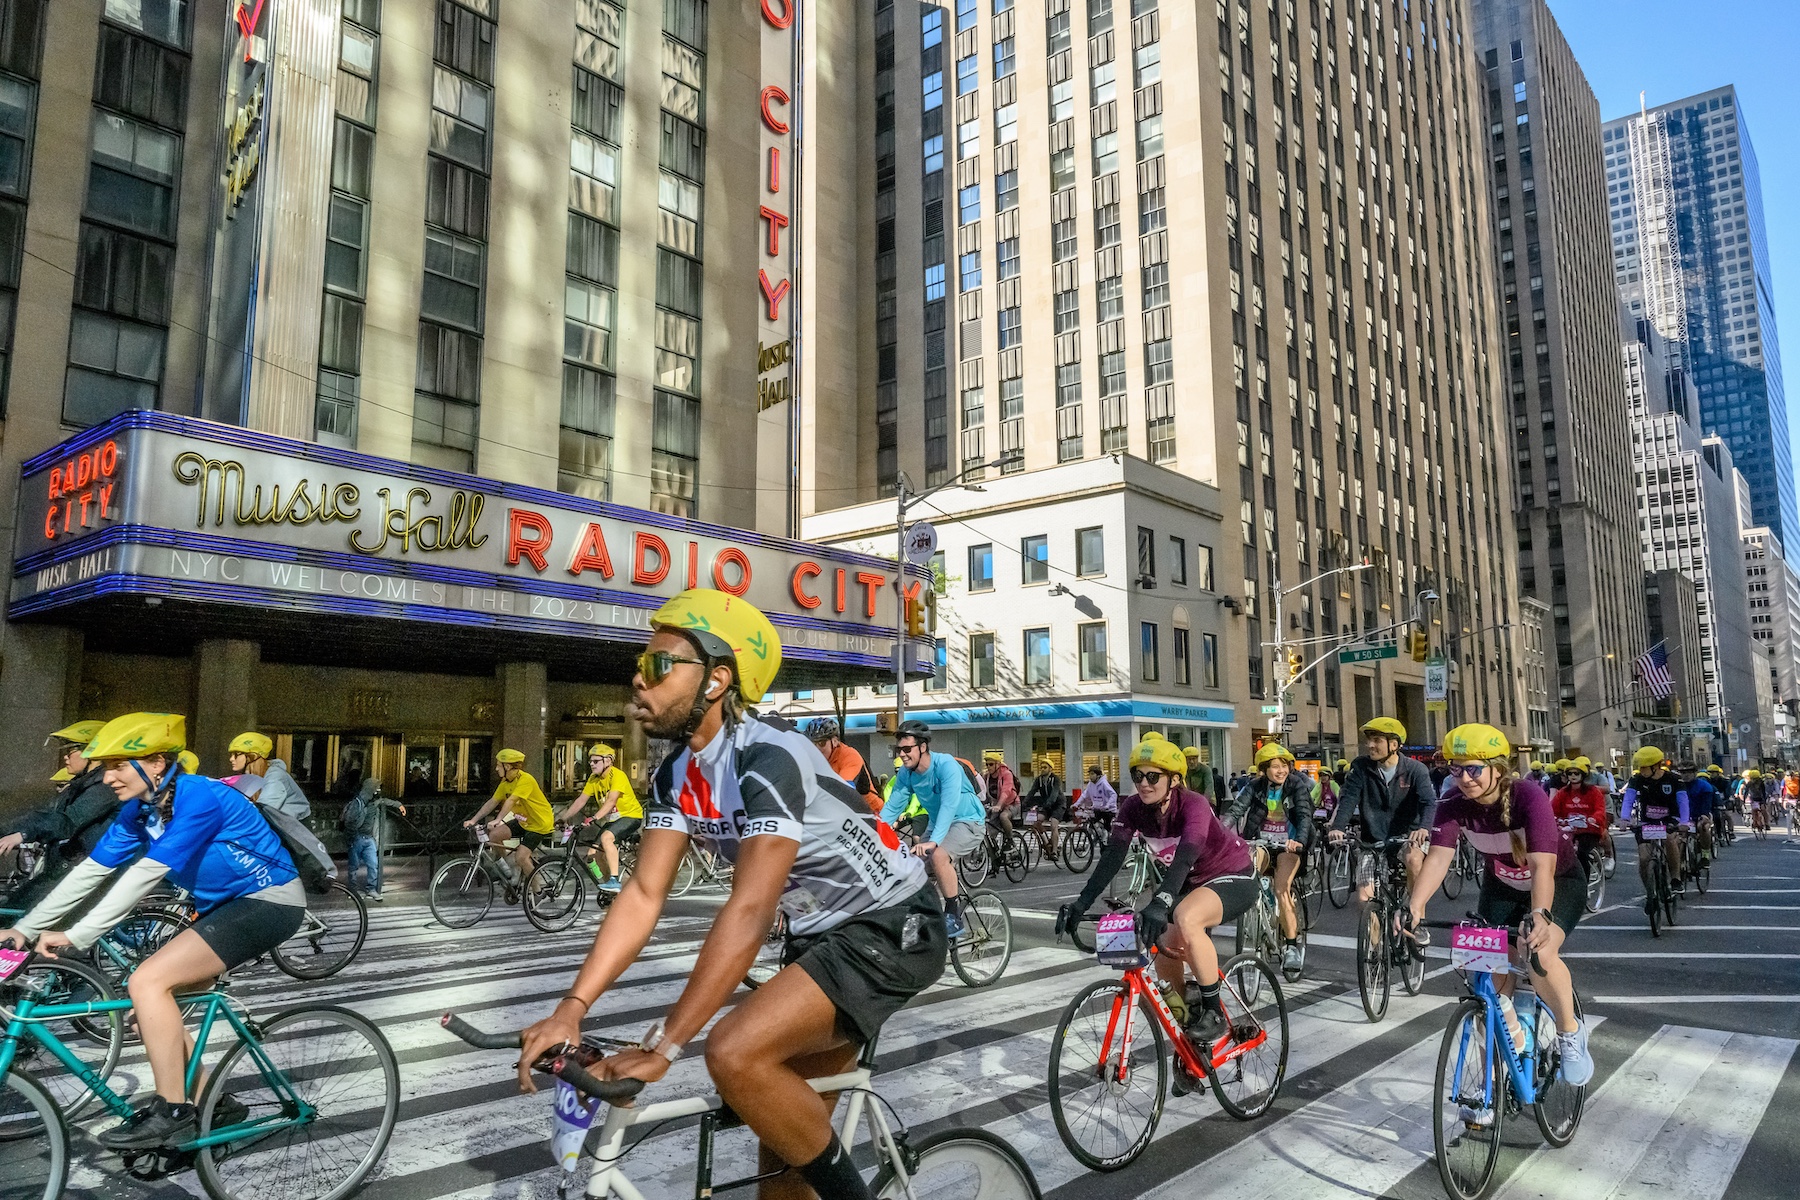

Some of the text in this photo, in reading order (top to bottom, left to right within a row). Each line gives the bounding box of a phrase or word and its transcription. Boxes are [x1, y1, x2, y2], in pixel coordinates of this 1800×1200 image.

[760, 85, 791, 321] CITY
[48, 441, 116, 500] RADIO
[45, 483, 113, 539] CITY
[173, 450, 488, 553] Music Hall
[36, 548, 112, 592] MUSIC HALL
[507, 507, 922, 624] RADIO CITY
[171, 550, 651, 627] NYC WELCOMES THE 2023 FIVE
[786, 628, 828, 647] TOUR
[845, 634, 877, 654] RIDE
[1353, 651, 1360, 660] W
[1362, 650, 1372, 659] 50
[967, 708, 1046, 721] WARBY PARKER
[1161, 706, 1209, 718] WARBY PARKER
[649, 816, 674, 828] RS
[835, 834, 863, 861] RACING
[1500, 867, 1532, 880] 2463
[1099, 919, 1134, 931] 23304
[1456, 933, 1502, 950] 24631
